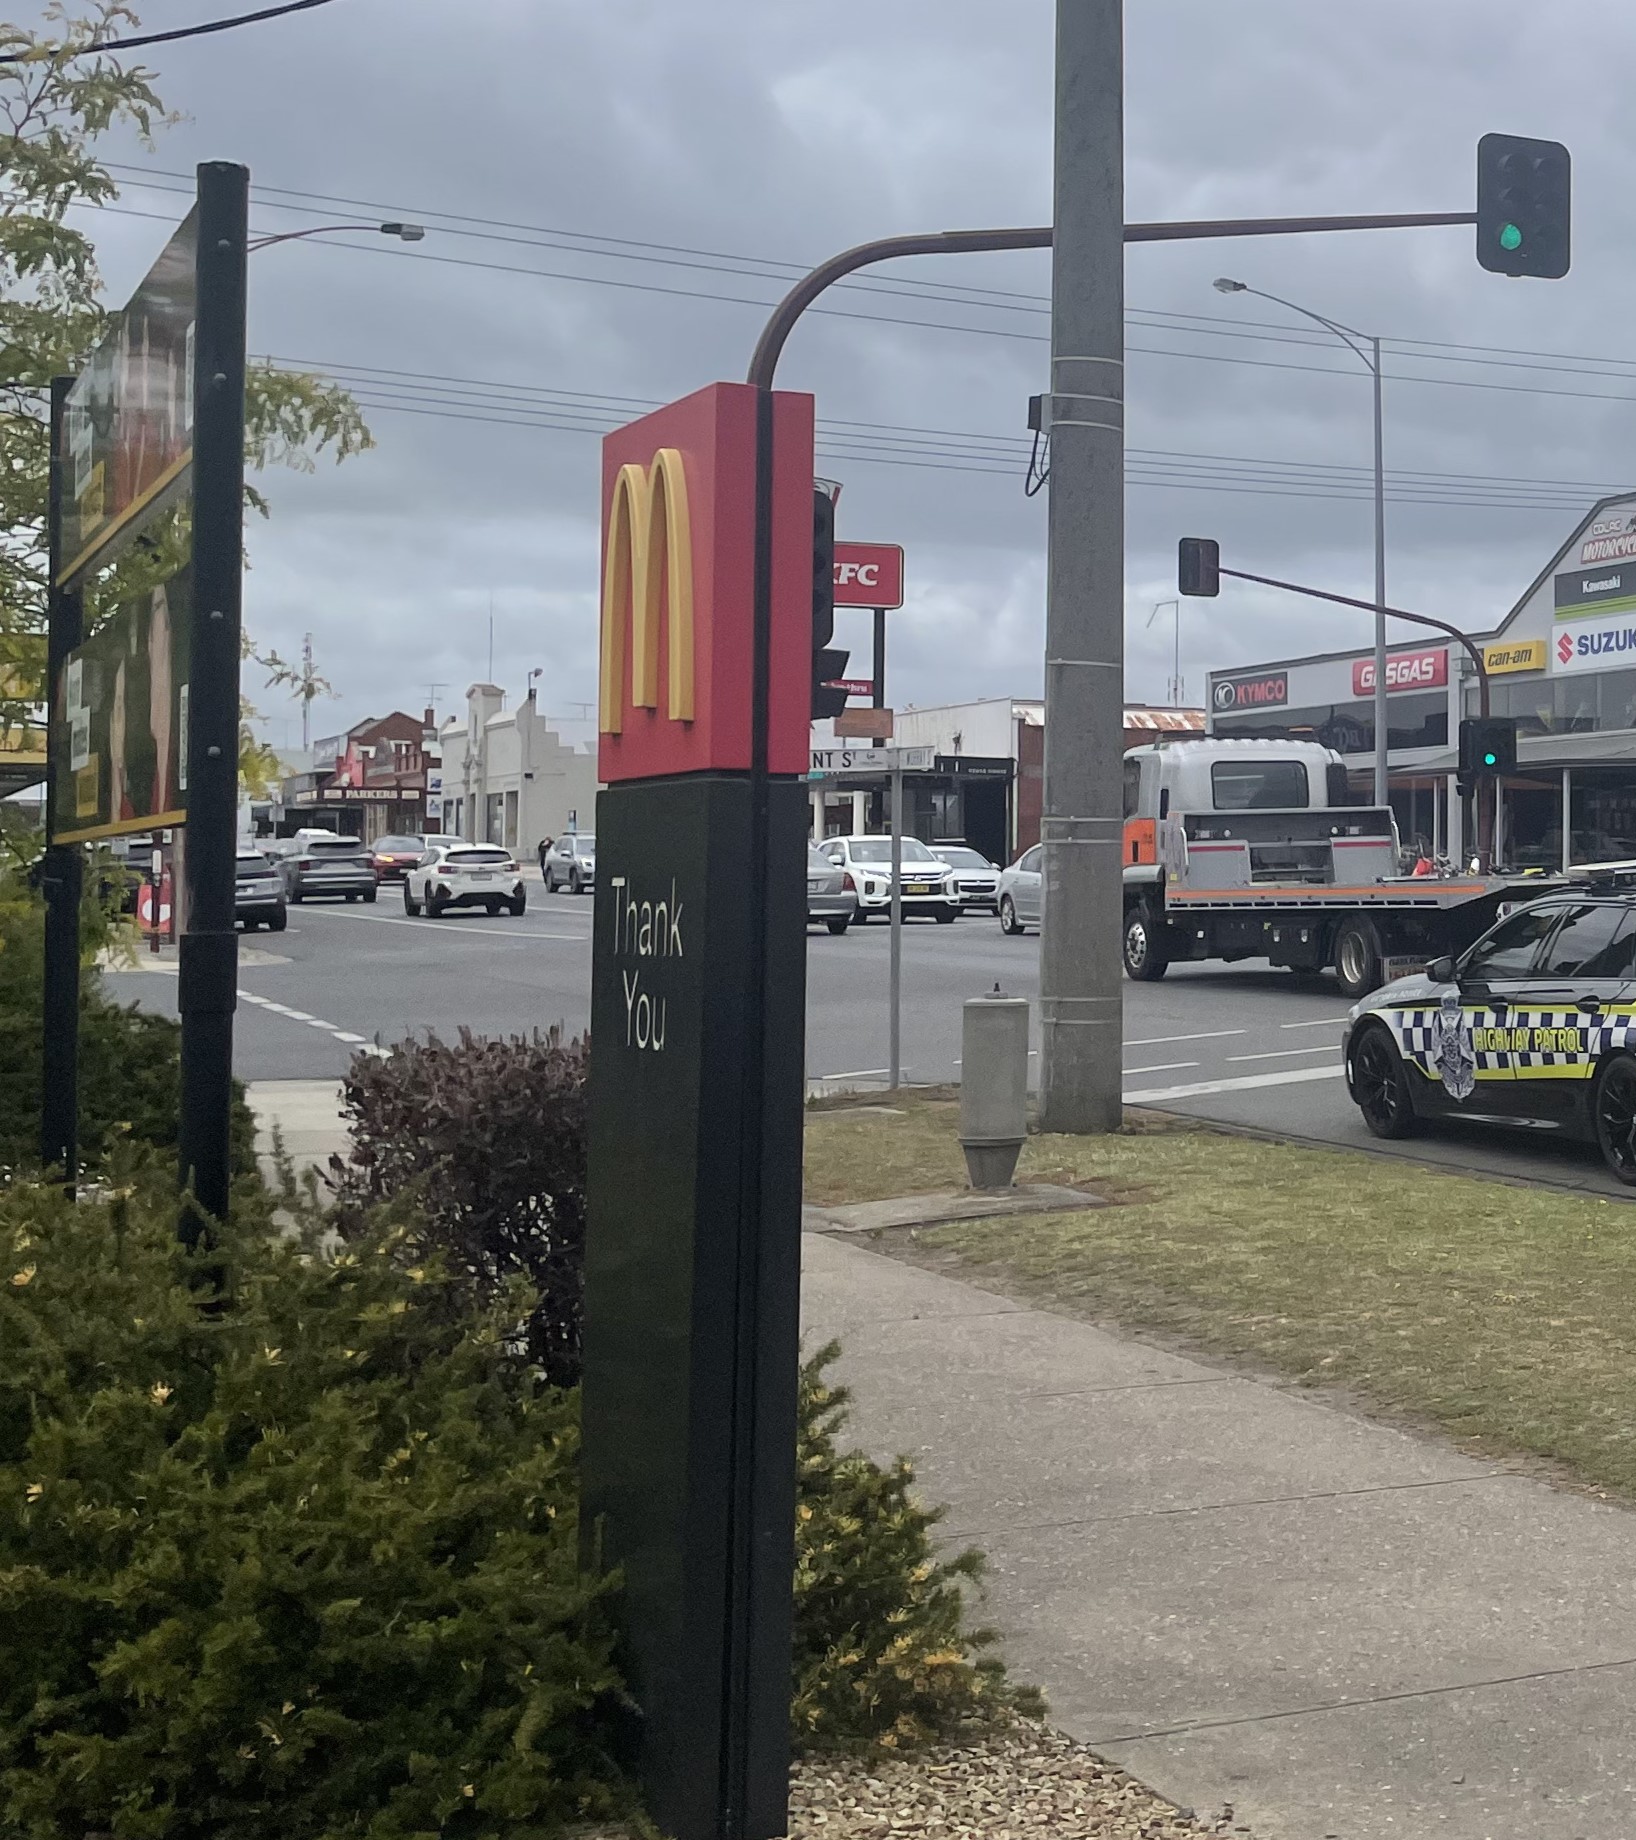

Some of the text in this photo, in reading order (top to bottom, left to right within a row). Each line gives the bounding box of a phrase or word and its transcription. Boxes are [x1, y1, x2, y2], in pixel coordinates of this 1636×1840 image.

[1592, 519, 1622, 535] COLAC
[1582, 575, 1621, 593] Kawasaki
[1488, 649, 1533, 667] can-am
[1361, 657, 1435, 688] GSGAS
[1237, 679, 1285, 704] KYMCO
[813, 752, 833, 768] NT
[611, 876, 683, 956] Thank
[623, 969, 666, 1051] You
[1475, 1027, 1584, 1052] HIGHWAY PATROL
